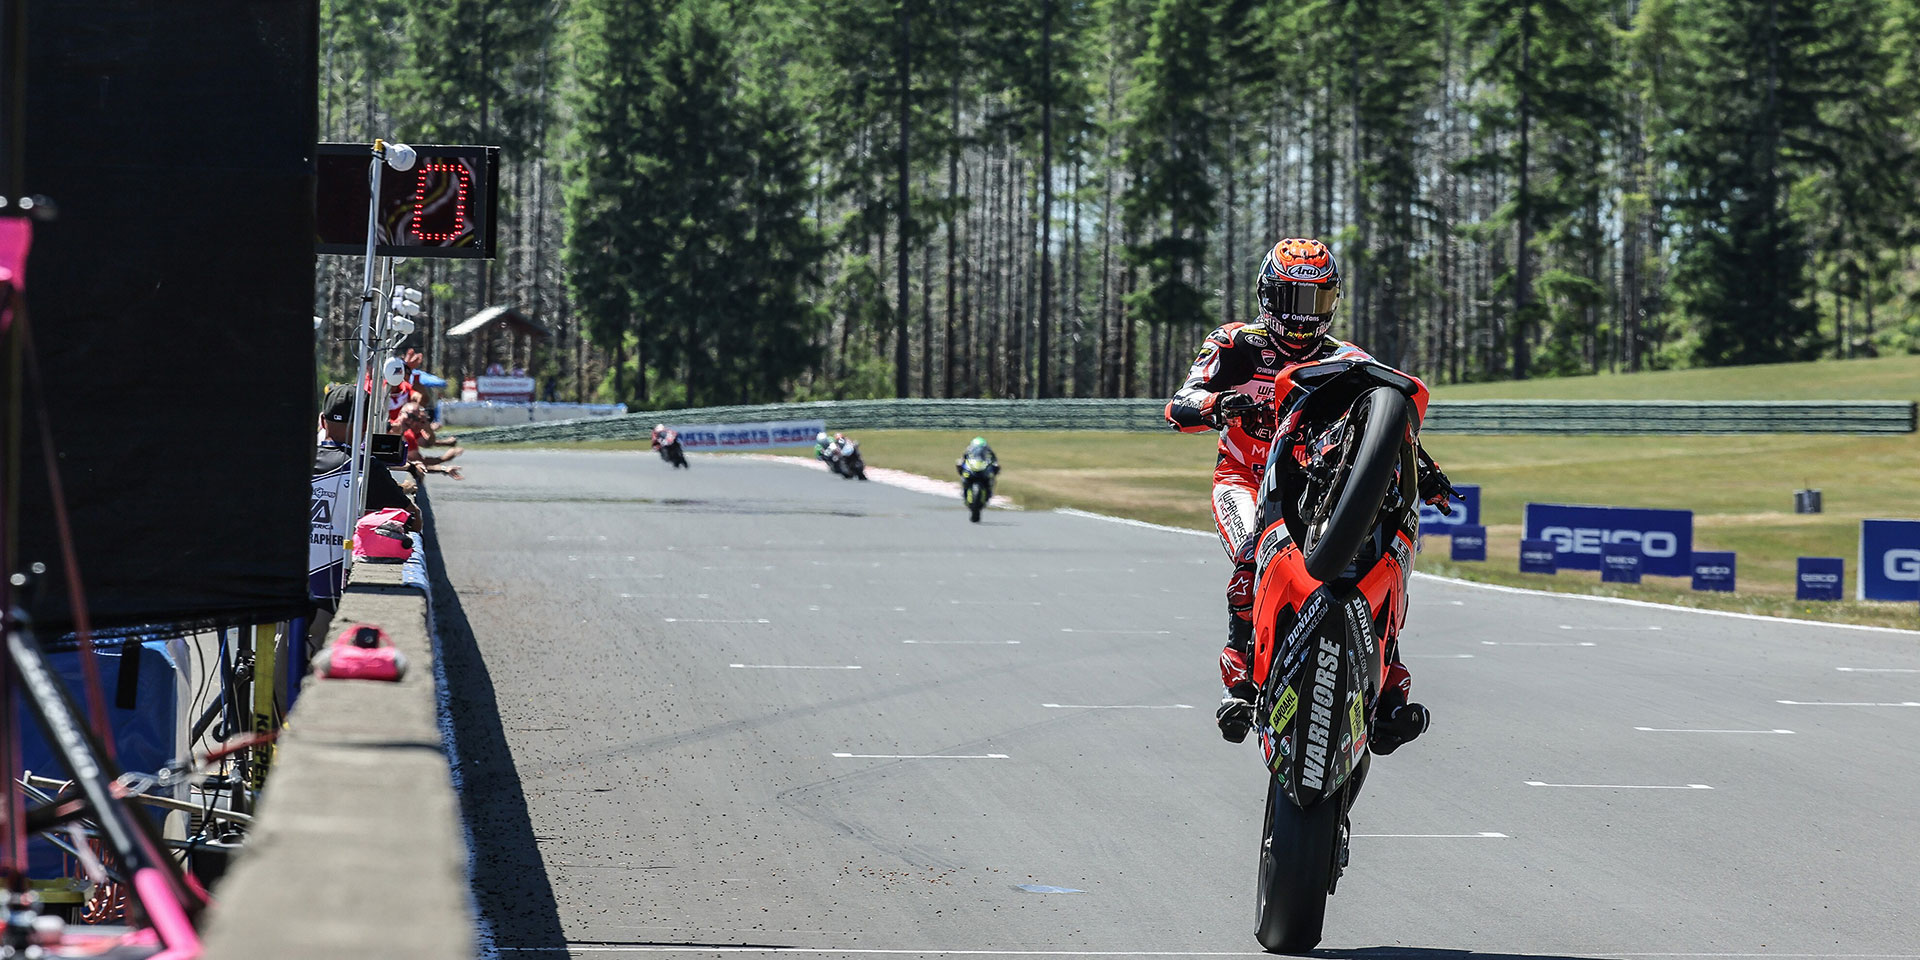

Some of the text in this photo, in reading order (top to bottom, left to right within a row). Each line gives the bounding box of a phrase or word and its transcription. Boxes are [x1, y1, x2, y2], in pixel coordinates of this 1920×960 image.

[412, 164, 469, 240] 0
[1294, 267, 1317, 276] Arai
[1291, 314, 1320, 323] OnlyFans
[1287, 596, 1322, 647] DUNLOP
[1352, 596, 1374, 655] DUNLOP
[1272, 692, 1296, 727] BARDAHL
[1301, 636, 1341, 790] WARHORSE
